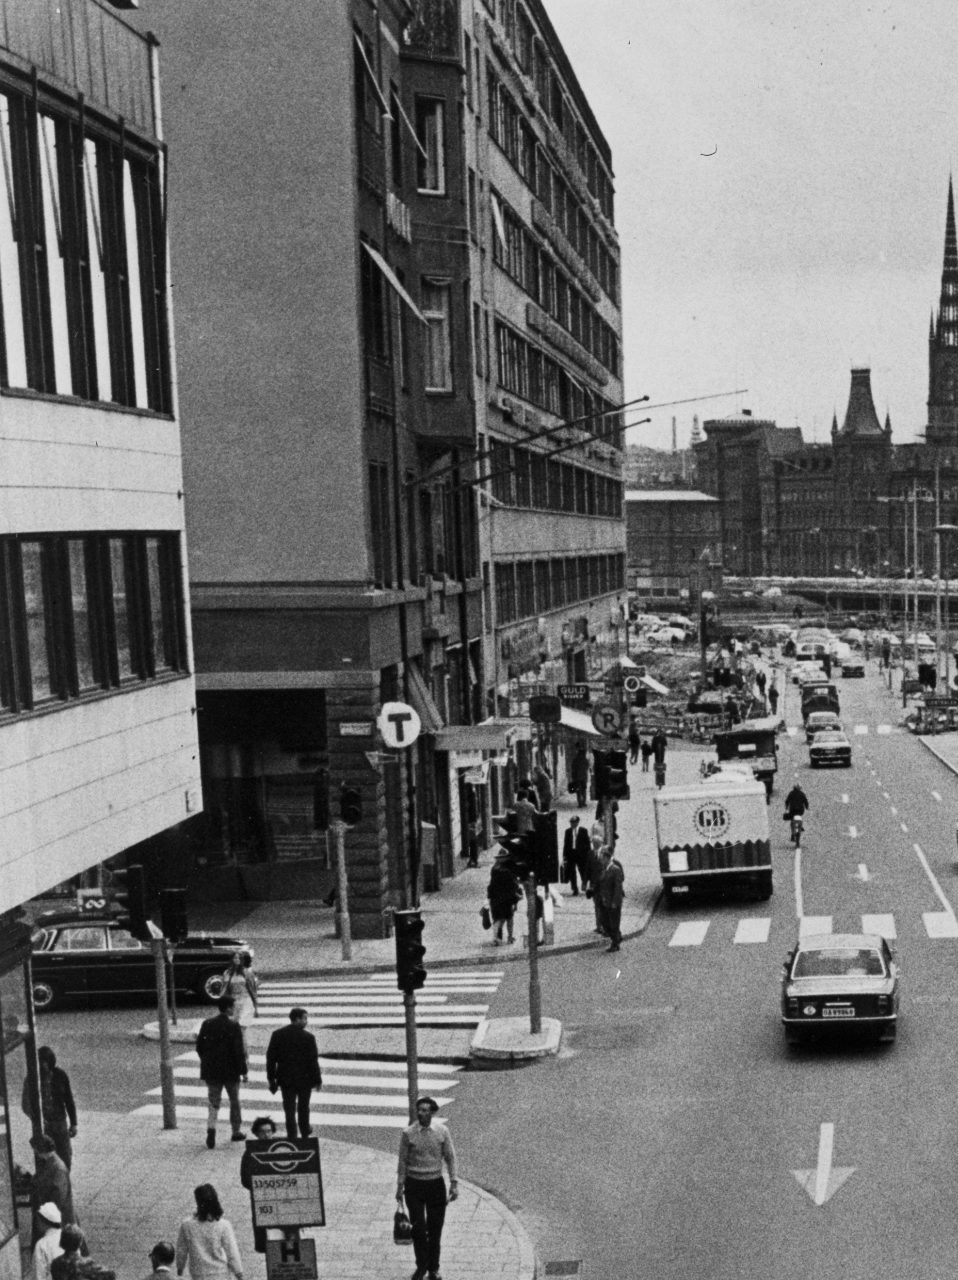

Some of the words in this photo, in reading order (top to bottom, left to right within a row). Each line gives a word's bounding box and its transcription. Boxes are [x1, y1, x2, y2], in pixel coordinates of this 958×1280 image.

[560, 686, 586, 694] GULD
[387, 712, 412, 742] T
[698, 809, 726, 827] GB
[281, 1241, 301, 1262] H
